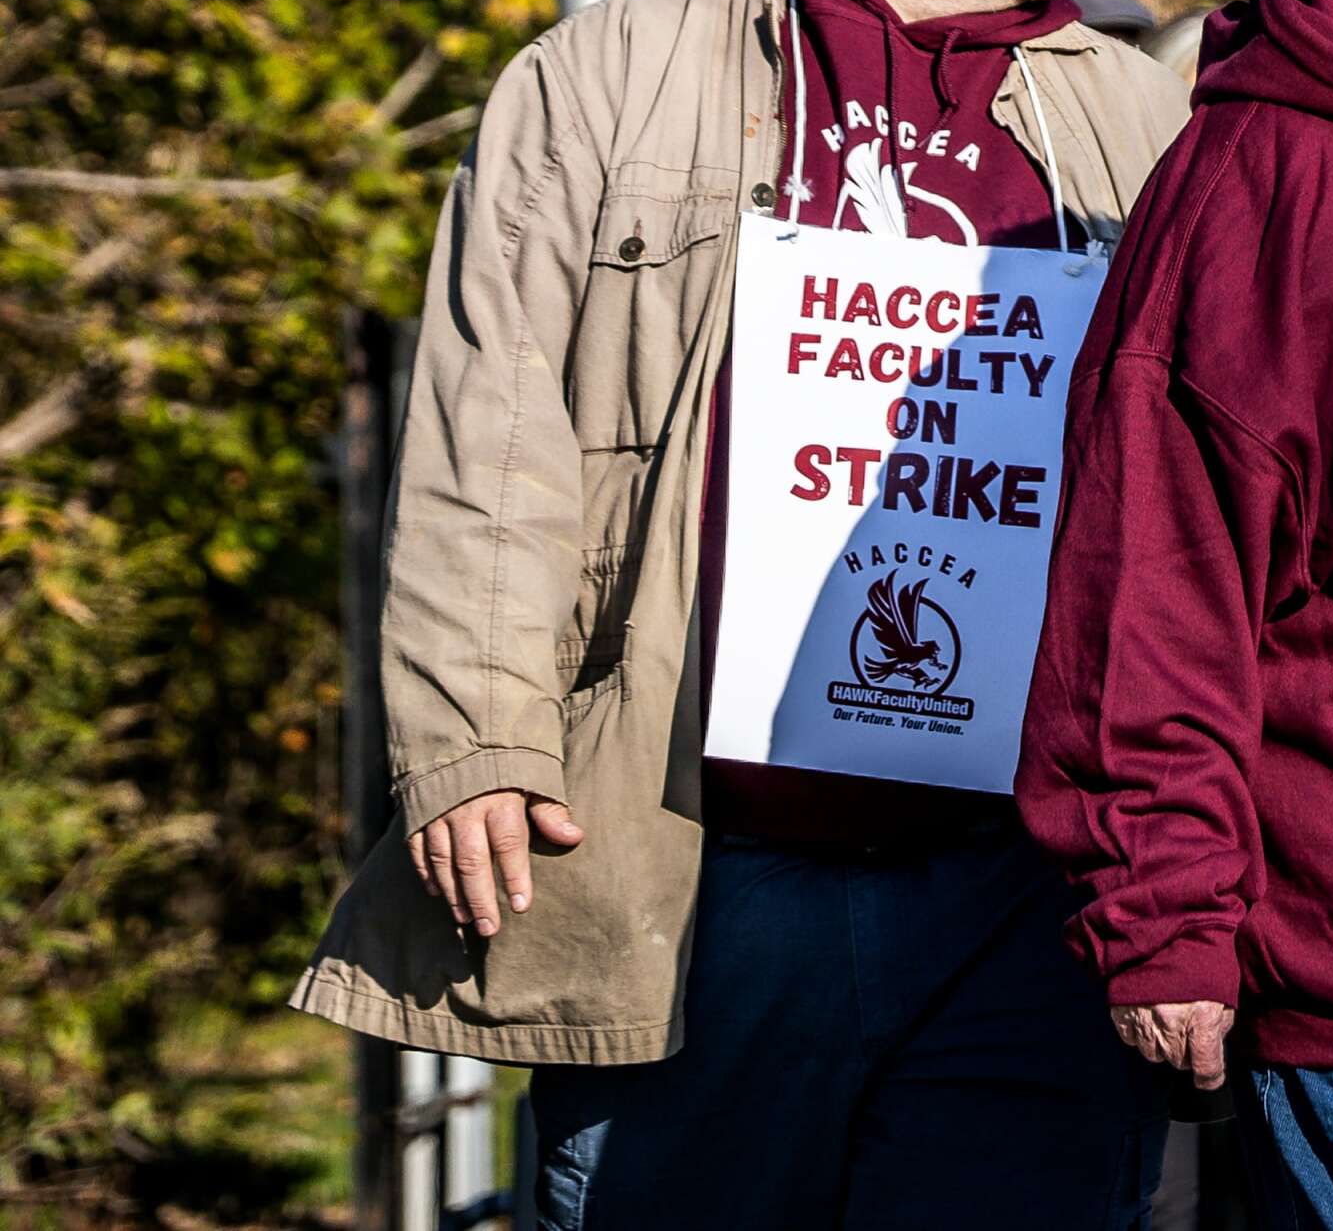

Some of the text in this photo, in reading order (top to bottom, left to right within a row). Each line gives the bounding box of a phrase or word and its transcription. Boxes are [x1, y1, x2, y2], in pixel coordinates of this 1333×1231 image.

[821, 100, 981, 172] HACCEA
[800, 275, 1044, 340] HACCEA
[788, 332, 1056, 397] FACULTY
[886, 396, 958, 445] ON
[789, 444, 1047, 528] STRIKE
[844, 542, 977, 589] HACCEA
[833, 684, 969, 716] HAWKFacultyUnited
[833, 707, 964, 735] Our Future. Your Union.
